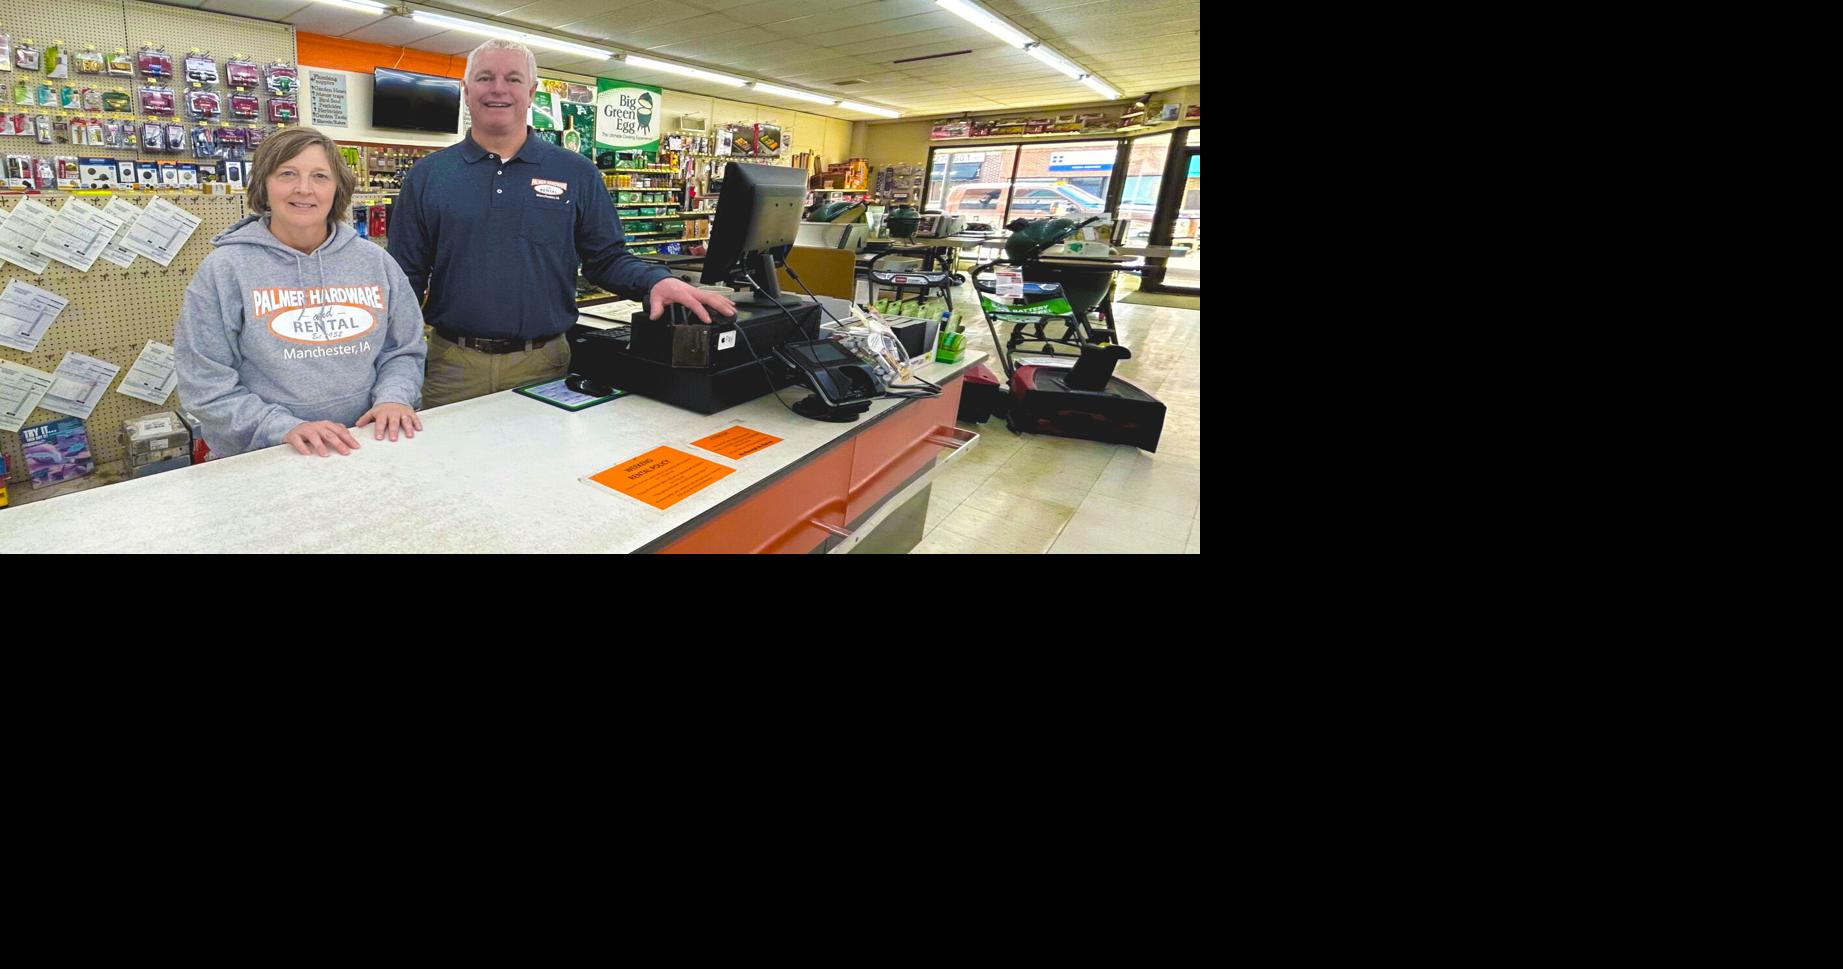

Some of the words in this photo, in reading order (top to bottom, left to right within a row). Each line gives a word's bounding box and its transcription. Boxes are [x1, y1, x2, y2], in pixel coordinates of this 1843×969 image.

[620, 94, 636, 110] Big
[604, 104, 636, 120] Green
[616, 118, 636, 134] Egg
[253, 289, 306, 317] PALMER
[309, 285, 384, 309] HARDWARE
[293, 317, 360, 334] RENTAL
[284, 344, 358, 360] Manchester,
[359, 340, 371, 353] IA
[23, 427, 39, 440] TRY
